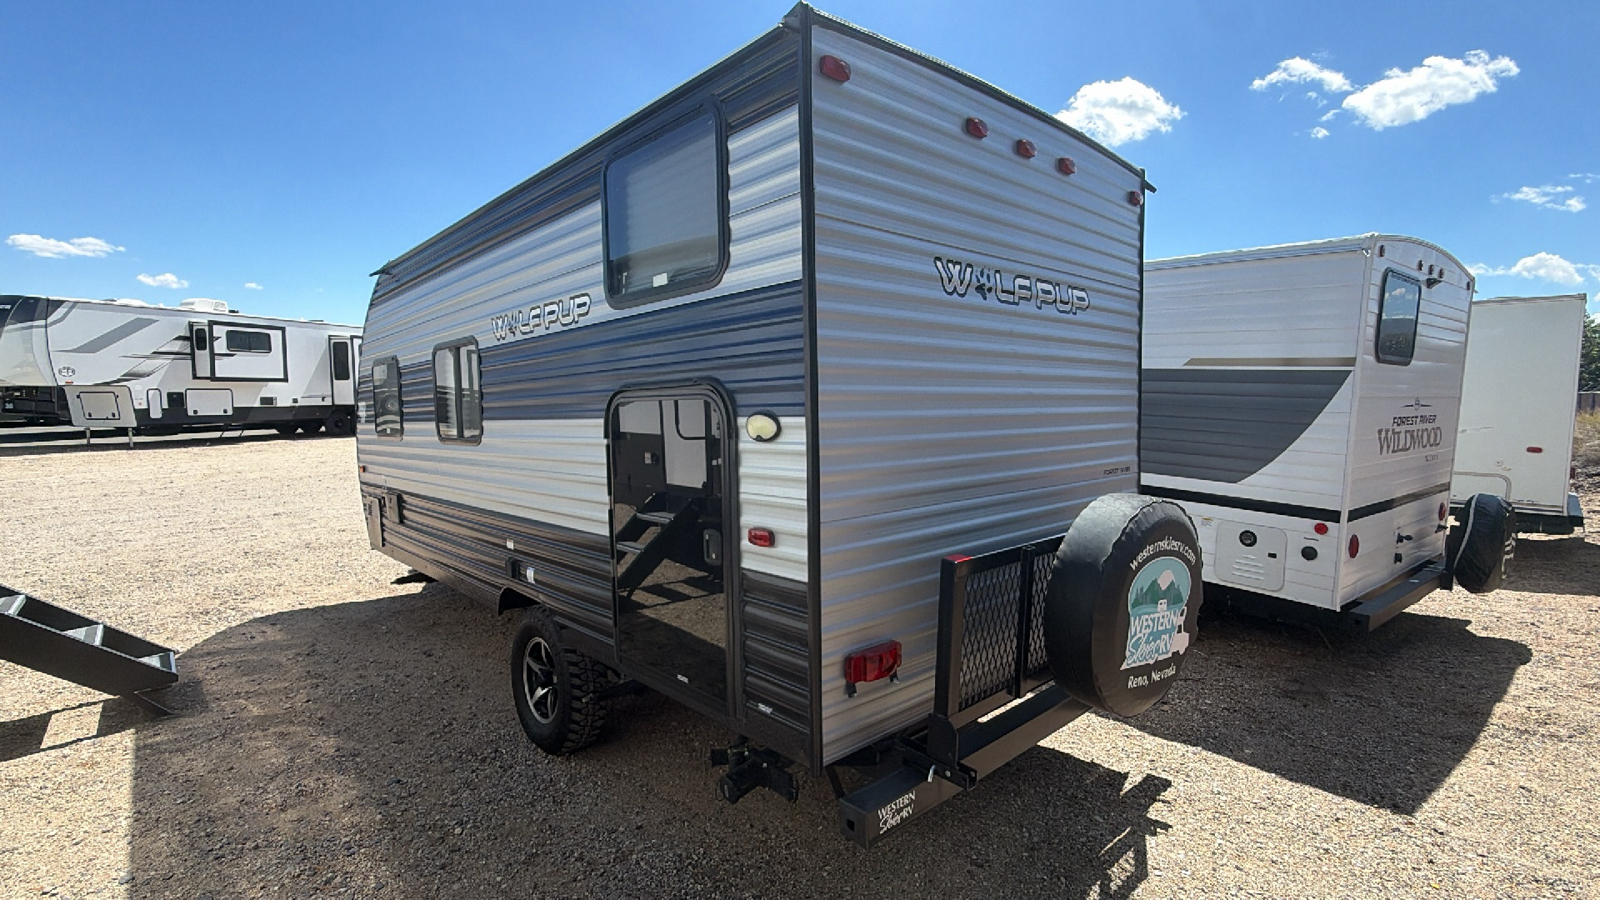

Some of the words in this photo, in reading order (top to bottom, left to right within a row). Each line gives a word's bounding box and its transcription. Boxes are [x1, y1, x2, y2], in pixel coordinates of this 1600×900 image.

[933, 256, 1032, 306] WLF
[1035, 278, 1090, 315] PUP
[491, 304, 541, 342] WLF
[543, 292, 592, 330] PUP
[1392, 415, 1419, 427] FOREST
[1419, 414, 1437, 425] RIVER
[1377, 426, 1443, 456] WILDWOOD
[1129, 536, 1197, 571] westernskiesrv.com
[1130, 610, 1179, 636] WESTERN
[1127, 633, 1160, 665] Skies
[1159, 632, 1175, 654] RV
[1127, 675, 1149, 689] Reno,
[1151, 663, 1177, 683] Nevada
[877, 790, 916, 820] WESTERN
[902, 804, 914, 819] RV
